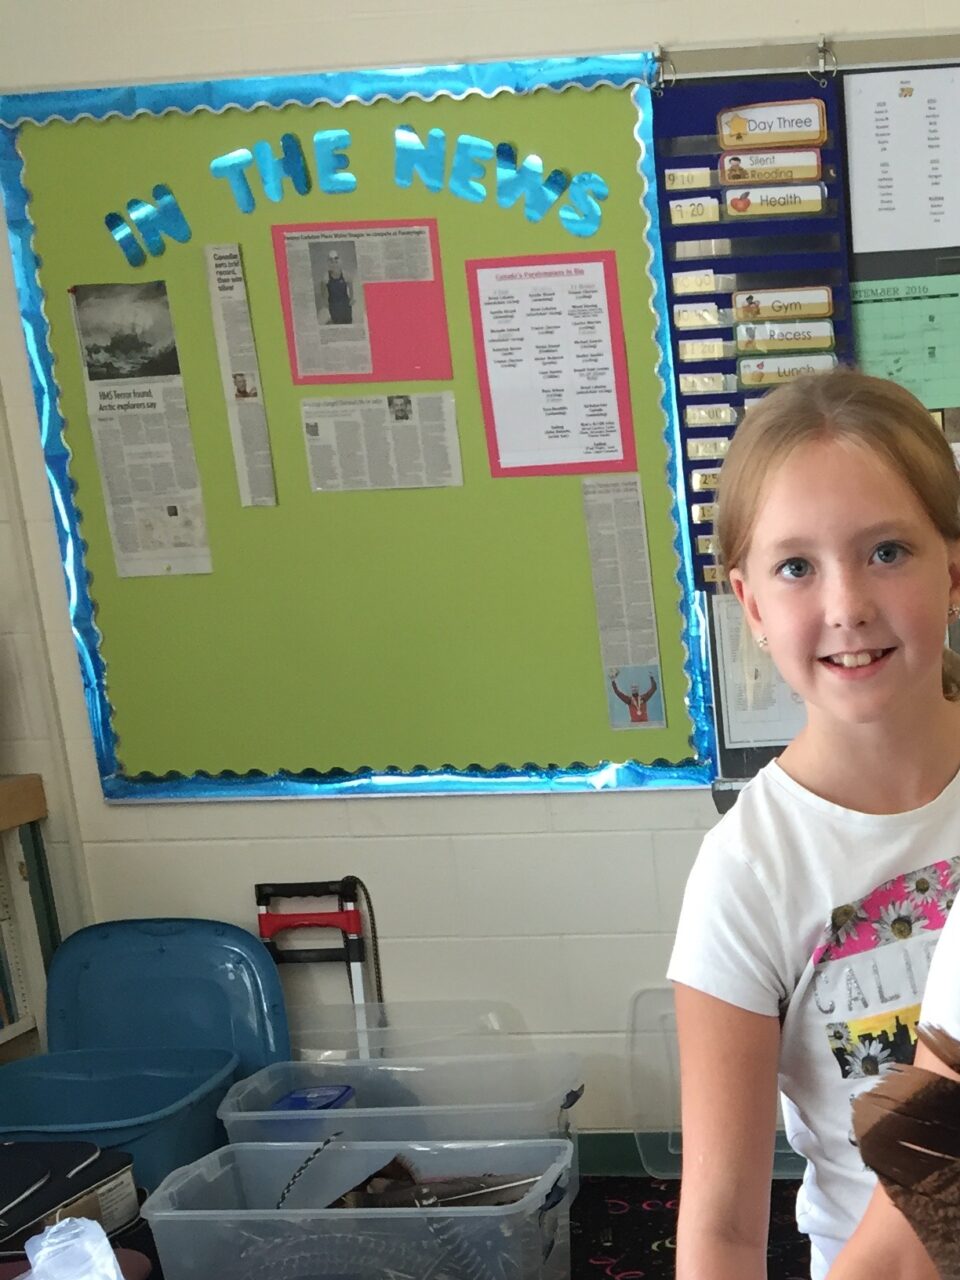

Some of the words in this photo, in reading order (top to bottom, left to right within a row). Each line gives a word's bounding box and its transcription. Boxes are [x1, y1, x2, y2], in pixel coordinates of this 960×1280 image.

[748, 119, 774, 133] Day
[777, 116, 813, 129] Three
[750, 155, 776, 166] Silent
[751, 168, 794, 181] Reading
[104, 182, 193, 268] IN
[210, 128, 357, 214] THE
[394, 123, 609, 239] NEWS
[760, 193, 802, 207] Health
[852, 286, 900, 299] PTEMBER
[905, 285, 929, 296] 2016
[771, 299, 802, 314] Gym
[769, 330, 813, 342] Recess
[777, 363, 816, 378] Lunch
